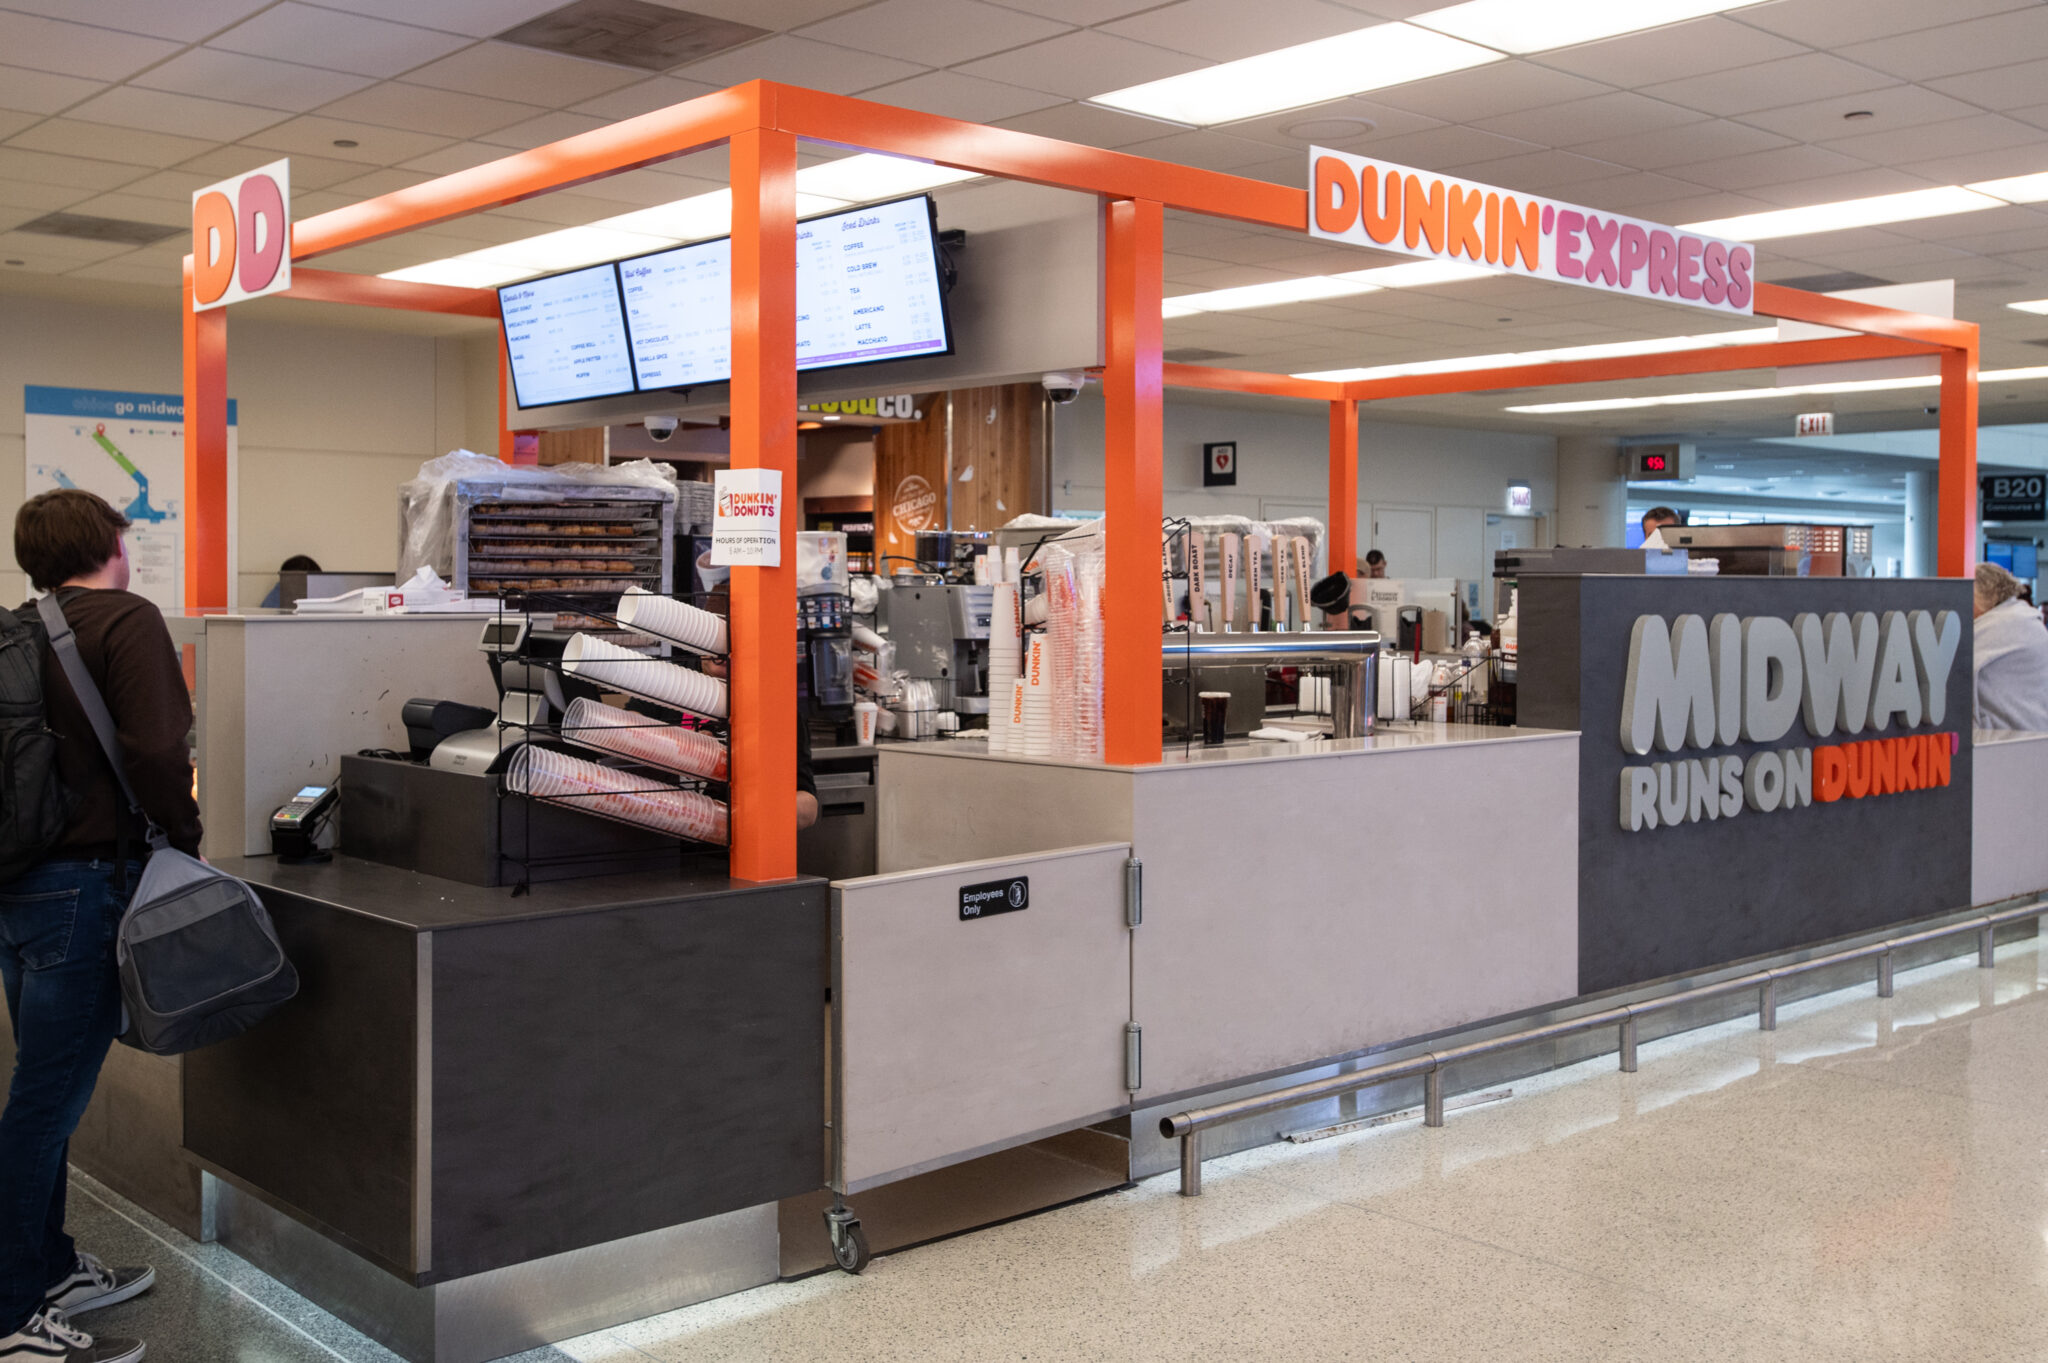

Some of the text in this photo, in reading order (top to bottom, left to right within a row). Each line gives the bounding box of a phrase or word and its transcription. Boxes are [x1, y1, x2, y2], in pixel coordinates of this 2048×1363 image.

[193, 174, 285, 305] DD
[843, 242, 864, 251] COFFEE
[847, 262, 878, 273] COLD BREW
[1556, 209, 1752, 310] EXPRESS
[853, 305, 884, 315] AMERICANO
[855, 323, 872, 331] LATTE
[857, 336, 888, 345] MACCHIATO
[138, 400, 184, 416] midwa
[1800, 415, 1827, 433] EXIT
[1993, 478, 2042, 498] B20
[734, 493, 777, 505] DUNKIN'
[893, 492, 936, 517] CHICAGO
[734, 505, 775, 517] DONUTS
[715, 537, 736, 545] HOURS
[743, 537, 776, 545] OPERATION
[1191, 545, 1199, 570] ROAST
[1031, 641, 1041, 686] DUNKIN'
[1620, 610, 1961, 755] MIDWAY
[1013, 684, 1023, 724] DUNKIN'
[1620, 732, 1960, 832] RUNS ON DUNKIN'
[963, 889, 1004, 903] Employees
[963, 905, 981, 916] Only
